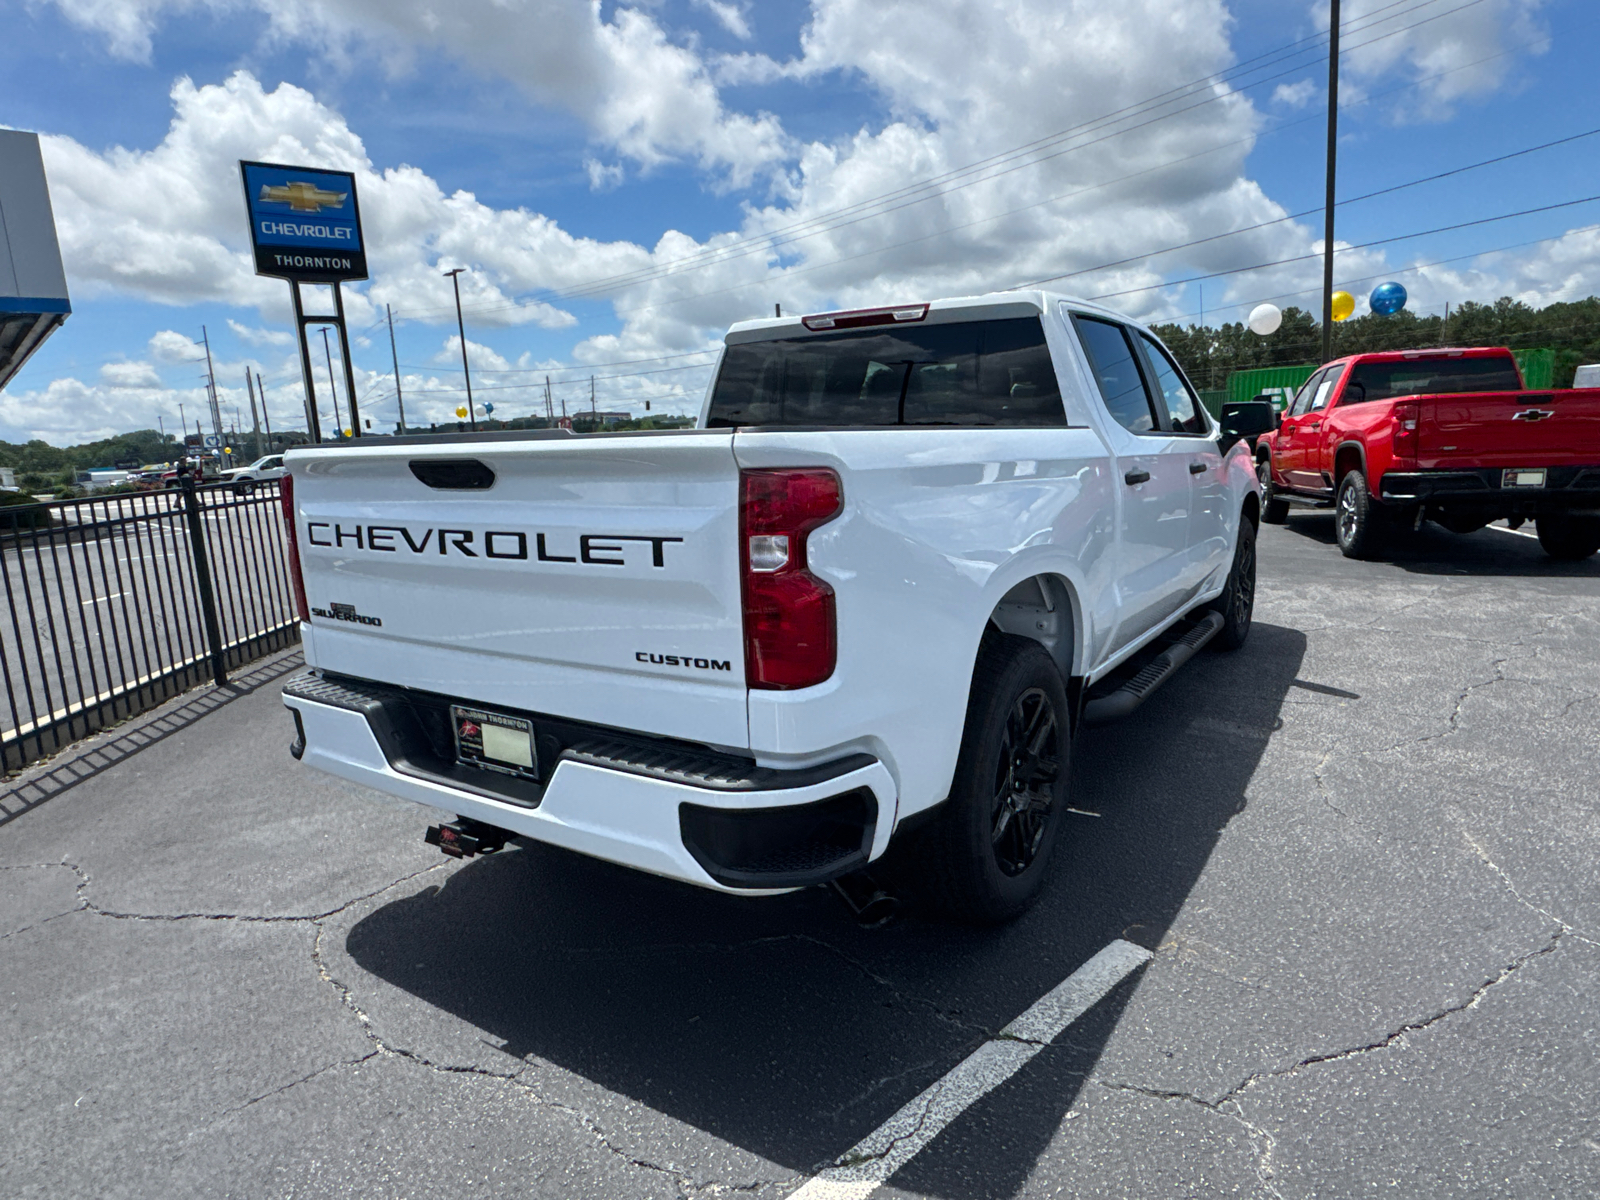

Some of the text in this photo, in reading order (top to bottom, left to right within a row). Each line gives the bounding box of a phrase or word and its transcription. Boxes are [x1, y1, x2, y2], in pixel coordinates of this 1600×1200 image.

[261, 221, 352, 239] CHEVROLET
[274, 254, 351, 269] THORNTON
[308, 522, 684, 567] CHEVROLET
[311, 607, 382, 627] SILVERADO
[635, 651, 731, 671] CUSTOM
